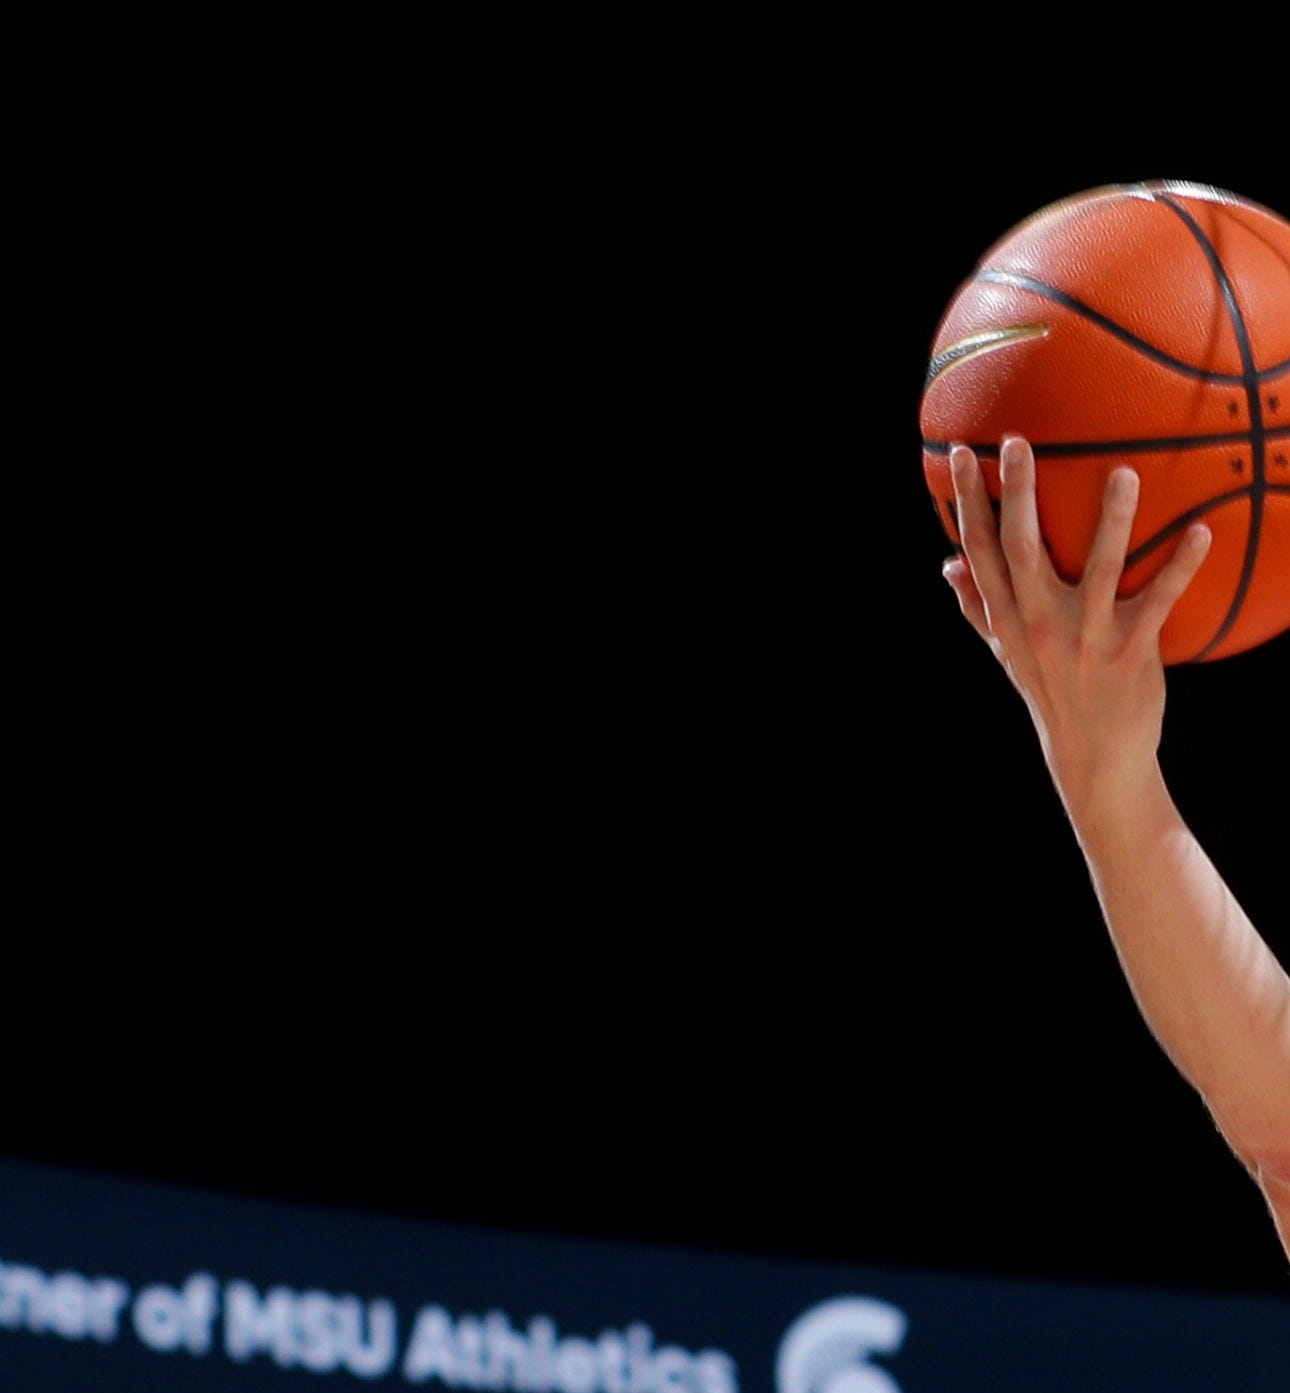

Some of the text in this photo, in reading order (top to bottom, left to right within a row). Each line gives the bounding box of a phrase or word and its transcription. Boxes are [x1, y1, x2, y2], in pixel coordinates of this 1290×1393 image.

[0, 1262, 128, 1340] ner
[133, 1274, 217, 1352] of
[223, 1281, 396, 1377] MSU
